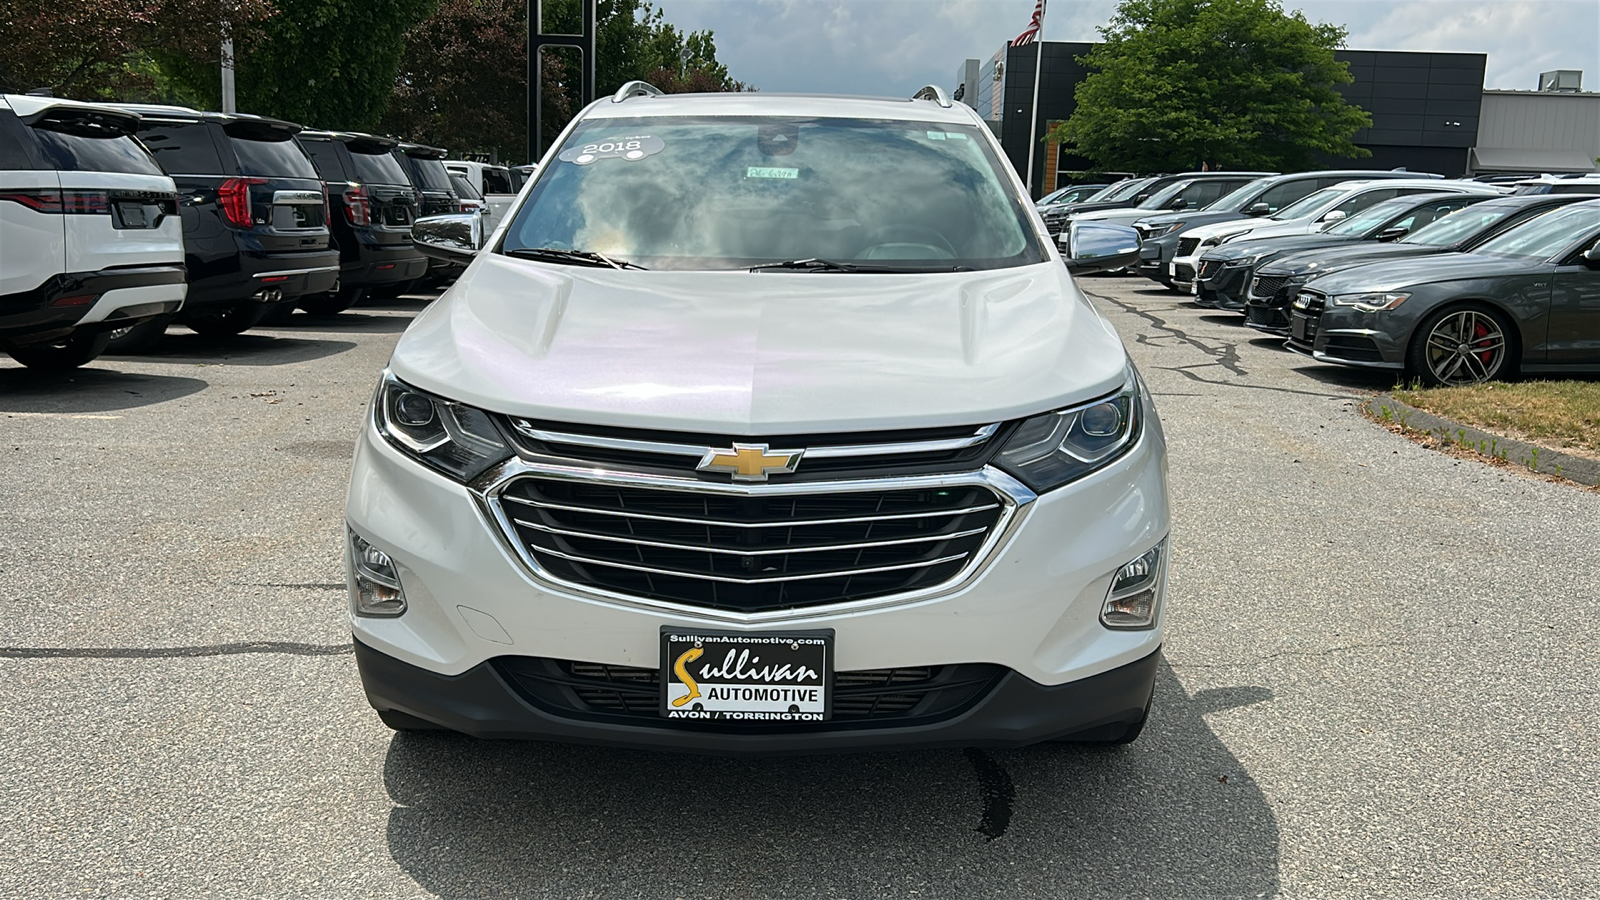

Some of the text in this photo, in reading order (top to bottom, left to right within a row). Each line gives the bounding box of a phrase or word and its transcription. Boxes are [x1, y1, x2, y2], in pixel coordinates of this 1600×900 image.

[582, 141, 641, 154] 2018
[669, 634, 825, 645] SullivanAutomotive.com
[671, 647, 818, 707] Sullivan
[708, 688, 818, 702] AUTOMOTIVE
[668, 711, 710, 719] AVON
[723, 712, 823, 721] TORRINGTON
